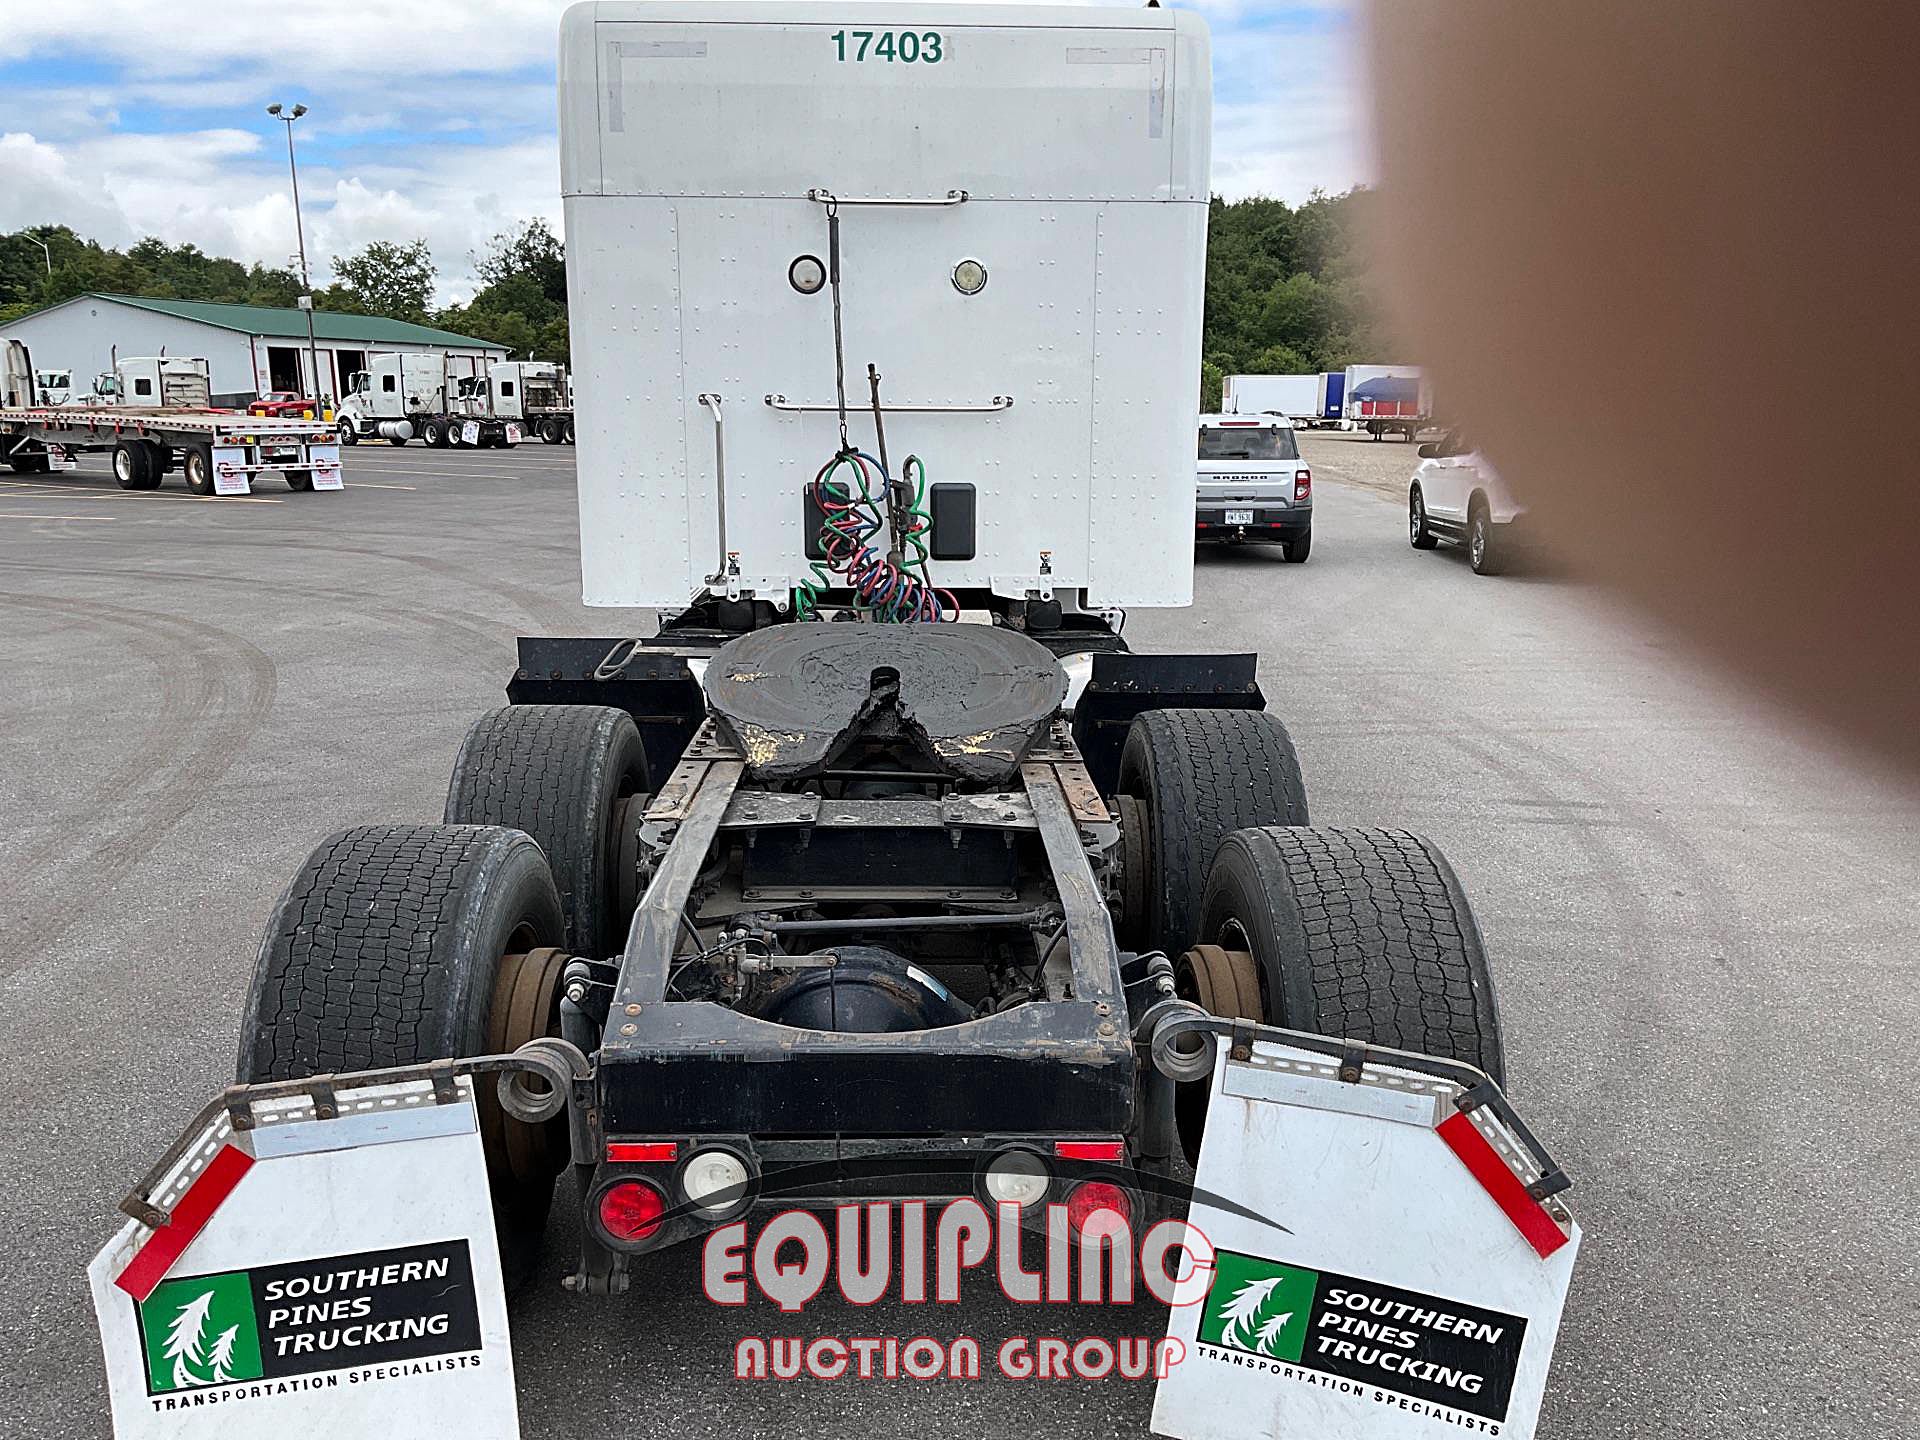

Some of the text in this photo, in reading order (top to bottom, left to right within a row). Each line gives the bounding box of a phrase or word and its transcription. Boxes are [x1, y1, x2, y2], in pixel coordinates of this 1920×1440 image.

[830, 30, 943, 64] 17403
[264, 1257, 449, 1301] SOUTHERN
[268, 1296, 371, 1329] PINES
[1317, 1311, 1420, 1350] PINES
[1323, 1288, 1504, 1345] SOUTHERN
[273, 1313, 450, 1357] TRUCKING
[152, 1354, 482, 1412] TRANSPORTATION SPECIALISTS
[1317, 1335, 1484, 1395] TRUCKING
[1197, 1346, 1501, 1437] TRANSPORTATION SPECIALISTS
